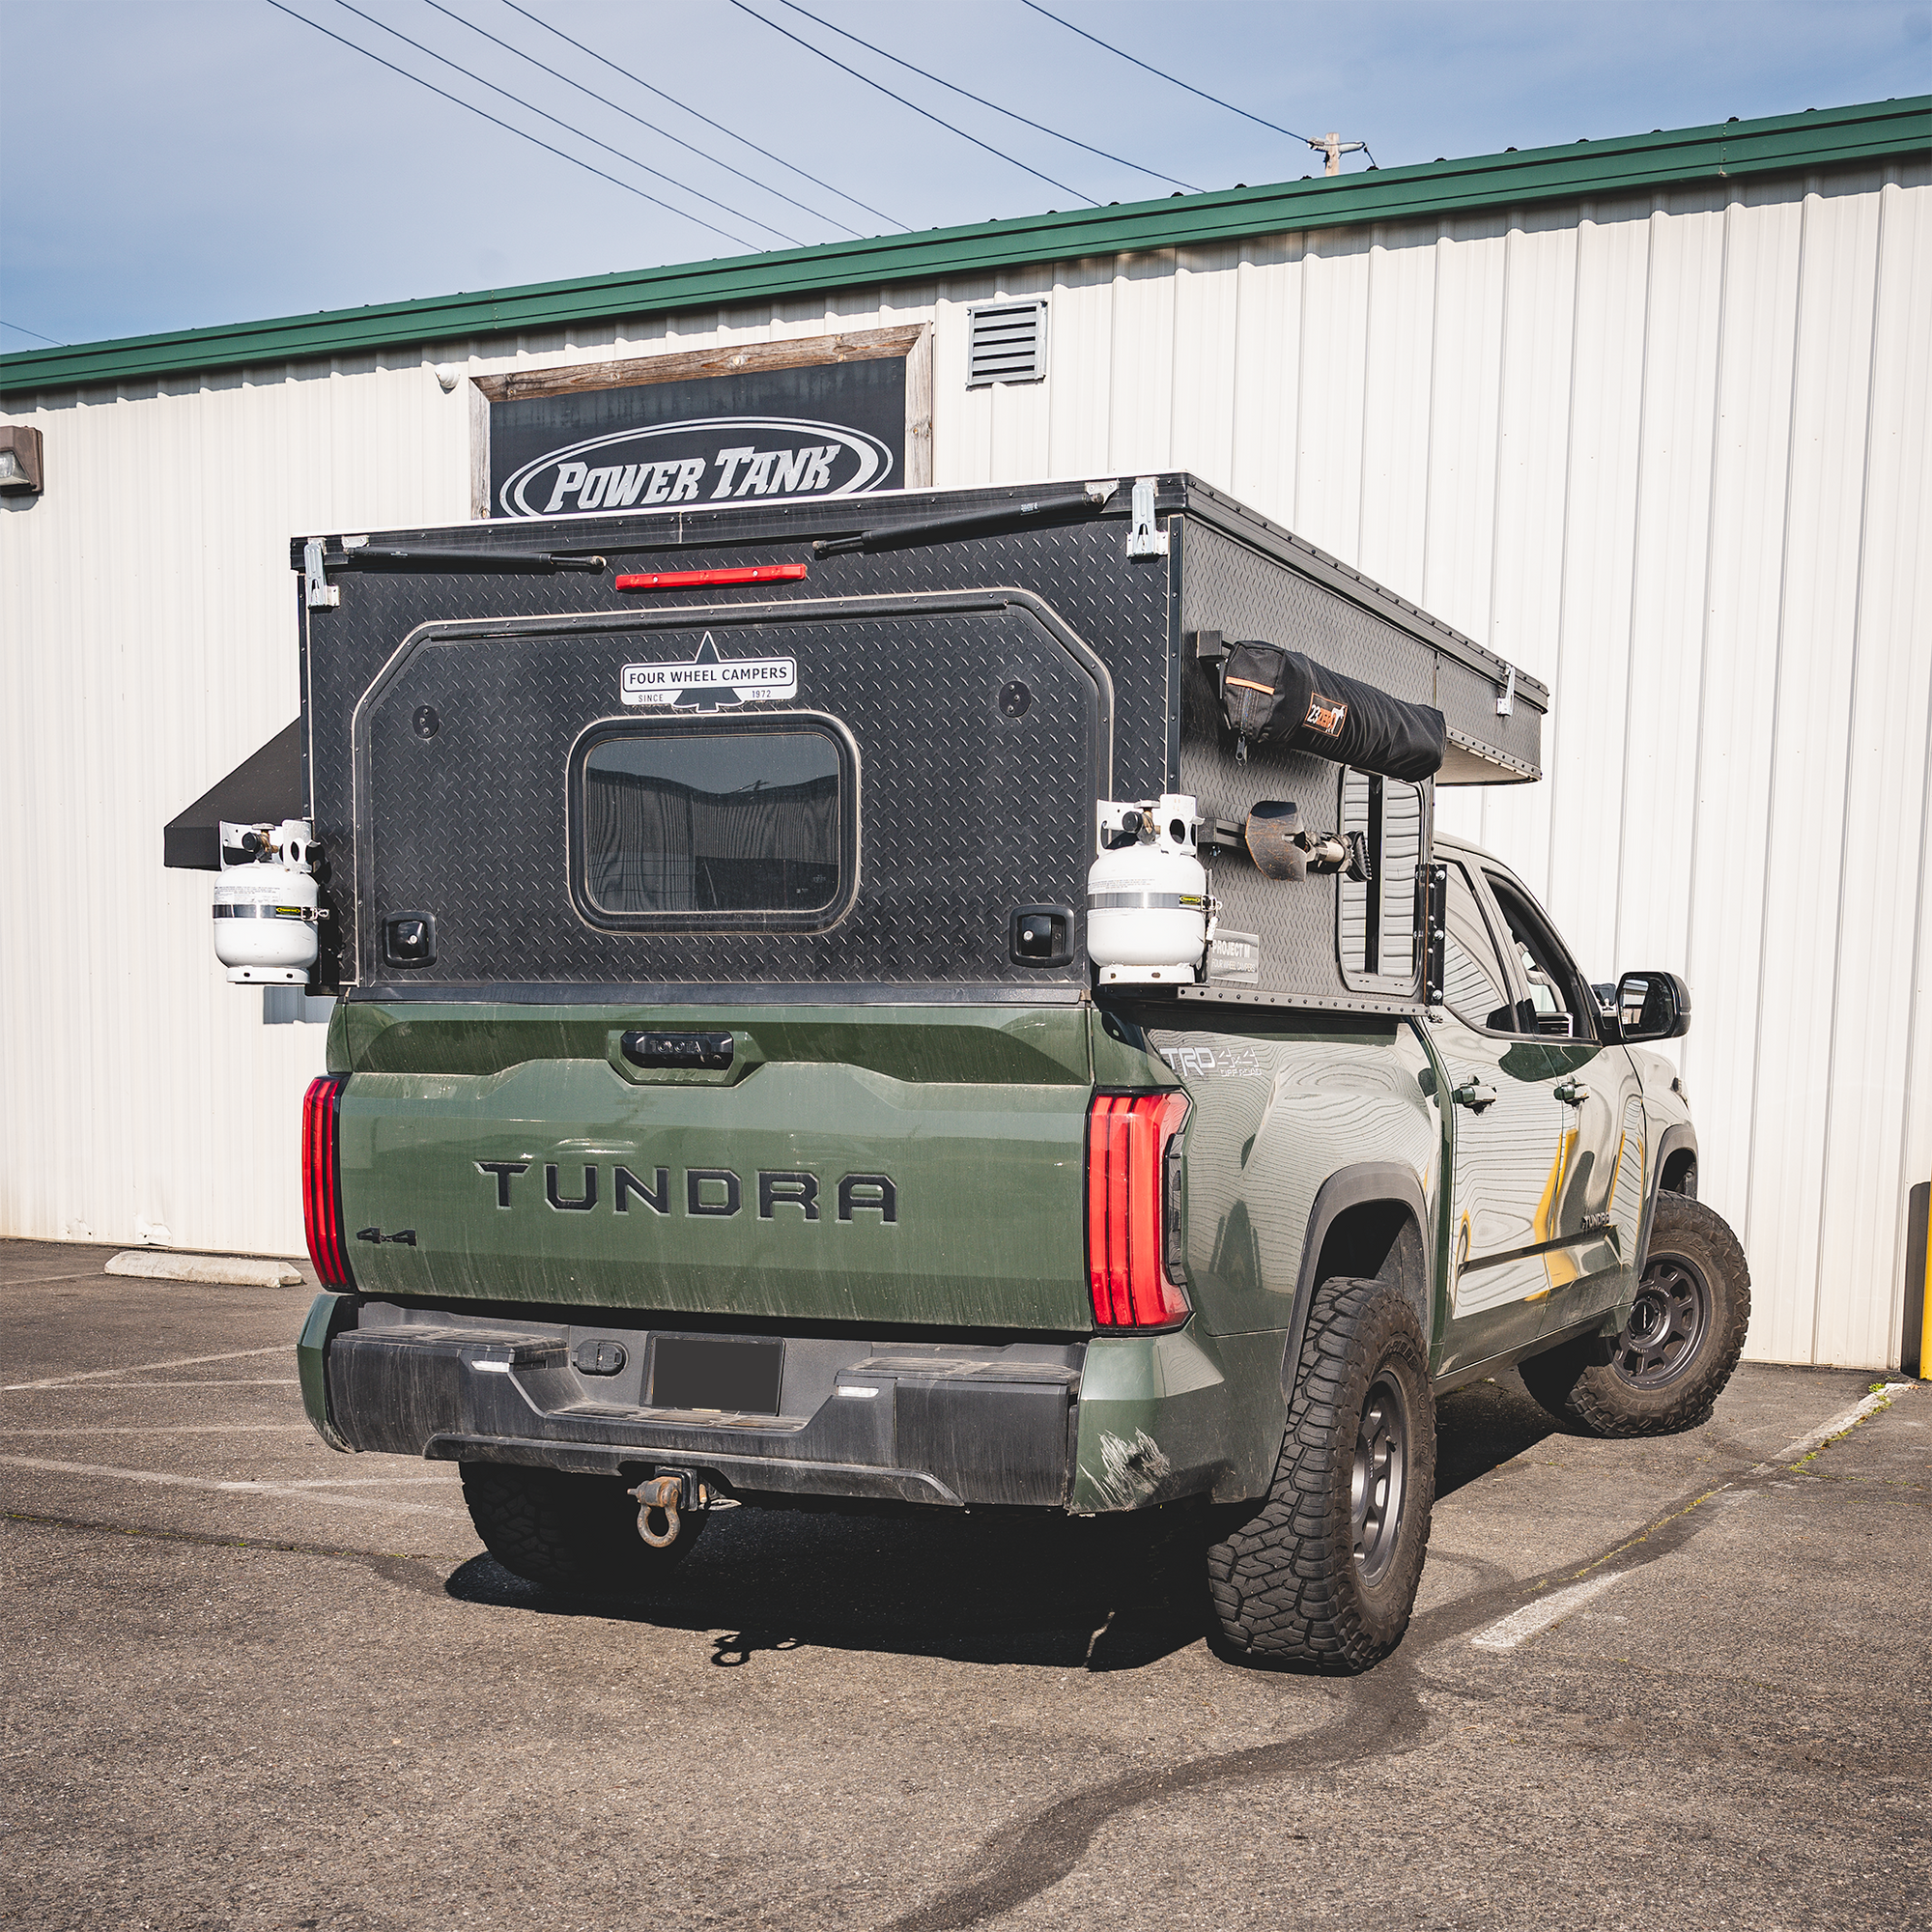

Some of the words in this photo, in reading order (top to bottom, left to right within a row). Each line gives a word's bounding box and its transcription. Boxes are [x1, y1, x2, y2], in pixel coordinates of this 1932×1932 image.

[629, 671, 666, 685] FOUR
[669, 669, 717, 683] WHEEL
[722, 667, 787, 681] CAMPERS
[638, 694, 664, 703] SINCE
[752, 690, 772, 698] 1972
[1212, 939, 1243, 957] PROJECT
[650, 1040, 703, 1054] TOYOTA
[1159, 1047, 1216, 1077] TRD
[472, 1160, 899, 1226] TUNDRA
